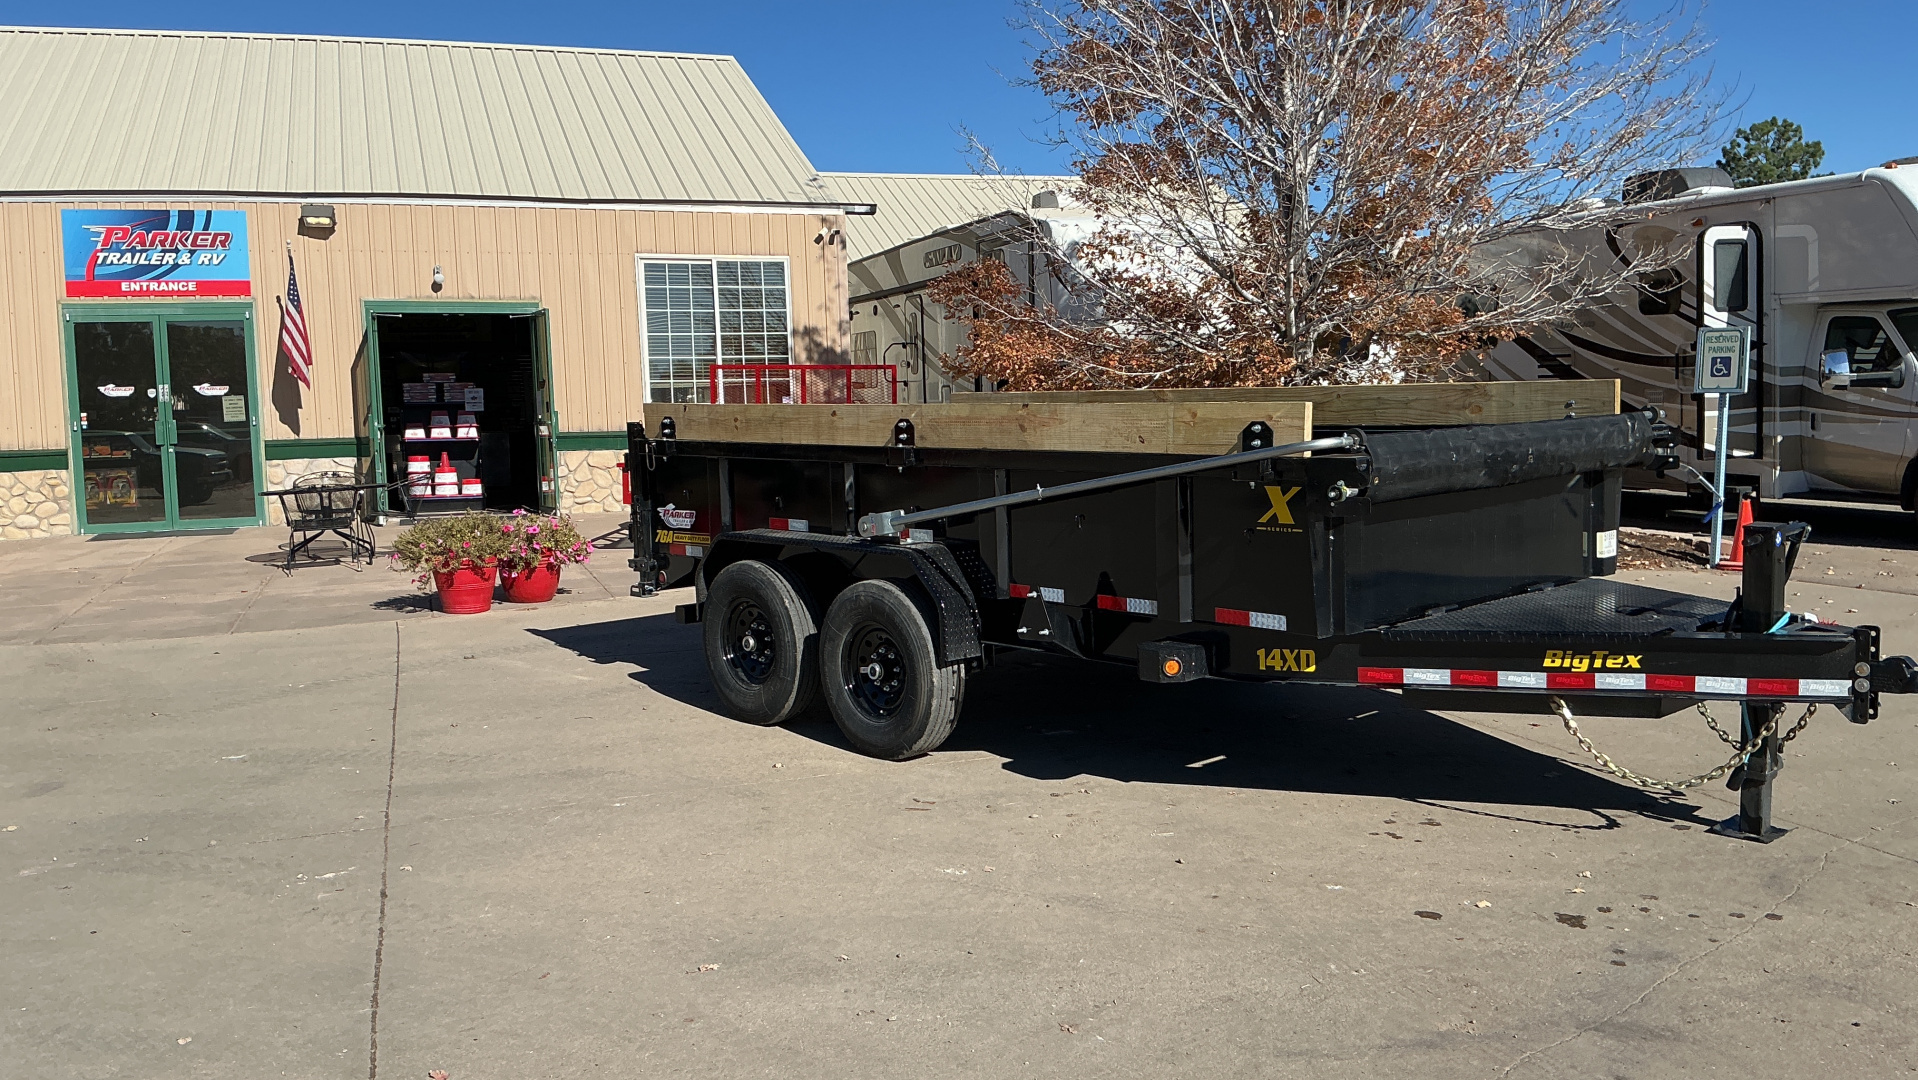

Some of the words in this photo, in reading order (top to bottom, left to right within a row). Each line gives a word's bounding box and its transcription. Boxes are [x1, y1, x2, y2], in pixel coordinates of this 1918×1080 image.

[99, 226, 233, 250] PARKER
[96, 252, 178, 265] TRAILER
[178, 252, 191, 265] &
[197, 253, 227, 266] RV
[121, 281, 197, 292] ENTRANCE
[1706, 334, 1739, 344] RESERVED
[1708, 345, 1736, 354] PARKING
[1257, 486, 1302, 524] X
[663, 509, 696, 519] PARKER
[655, 530, 674, 544] 7GA
[1256, 648, 1316, 673] 14XD
[1543, 650, 1643, 672] BigTex
[1367, 671, 1394, 680] BigTex
[1413, 672, 1440, 681] BigTex
[1507, 675, 1537, 684] BigTex
[1605, 676, 1635, 686] BigTex
[1705, 680, 1736, 689] BigTex
[1809, 683, 1840, 692] BigTex
